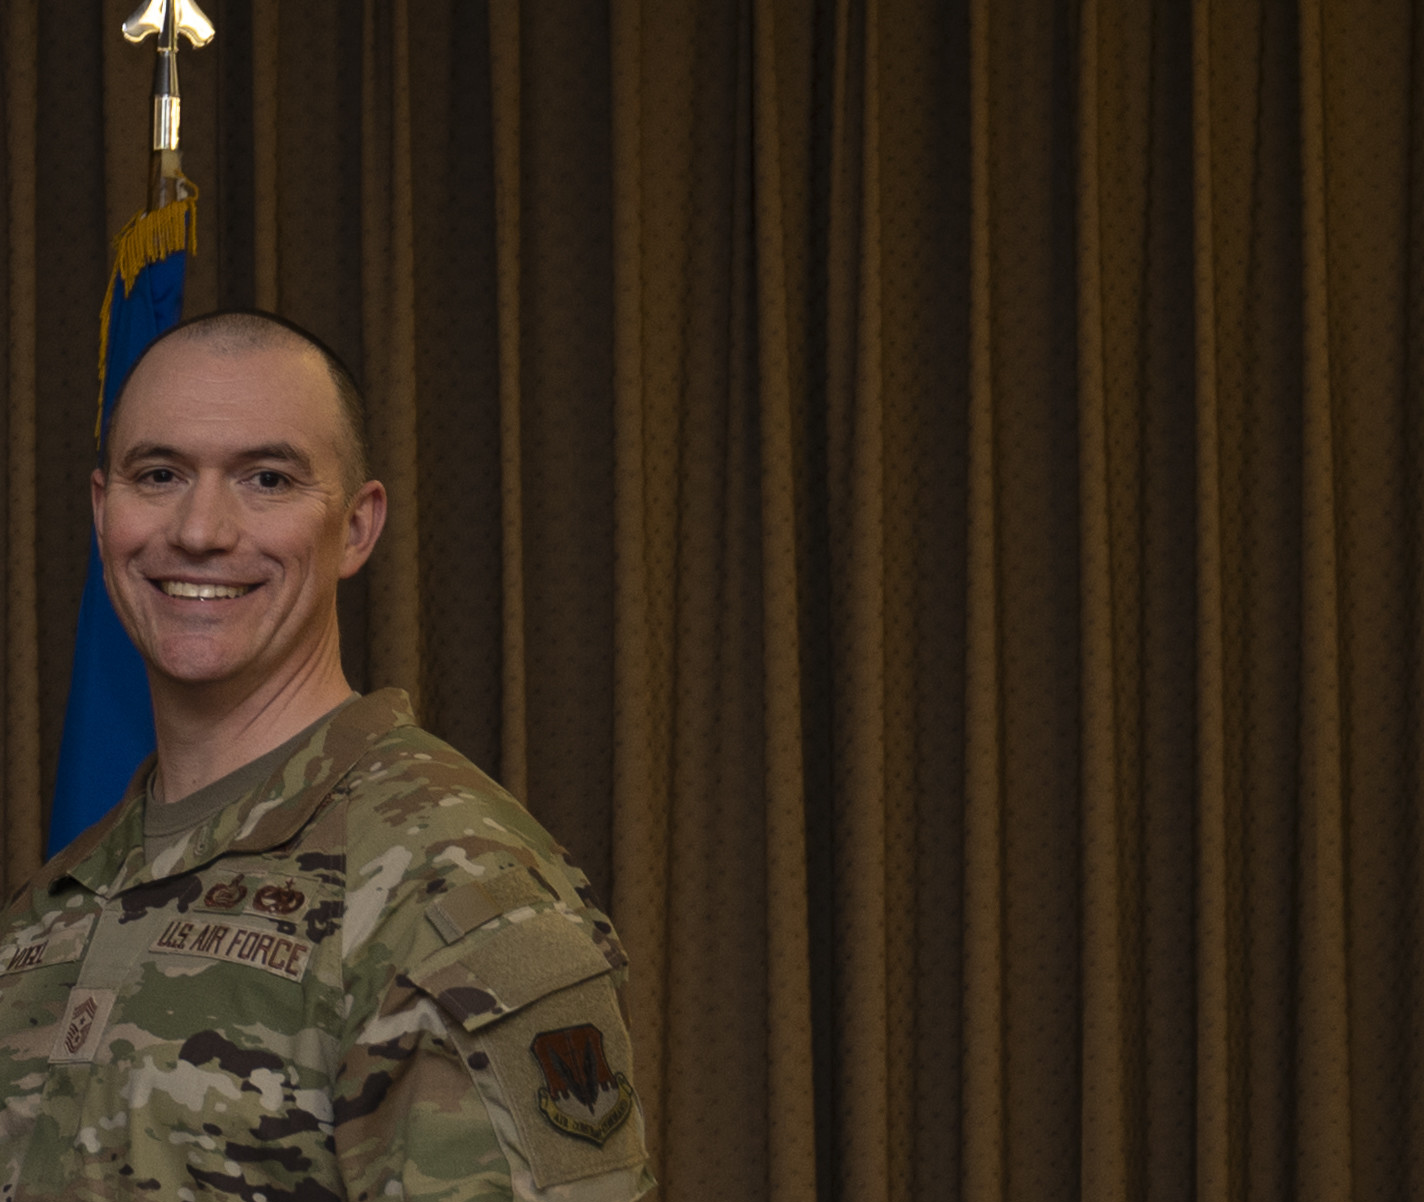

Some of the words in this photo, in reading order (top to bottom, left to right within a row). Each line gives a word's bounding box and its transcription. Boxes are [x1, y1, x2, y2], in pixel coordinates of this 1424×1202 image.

[157, 921, 189, 949] U.S.
[192, 924, 224, 953] AIR
[225, 928, 308, 977] FORCE
